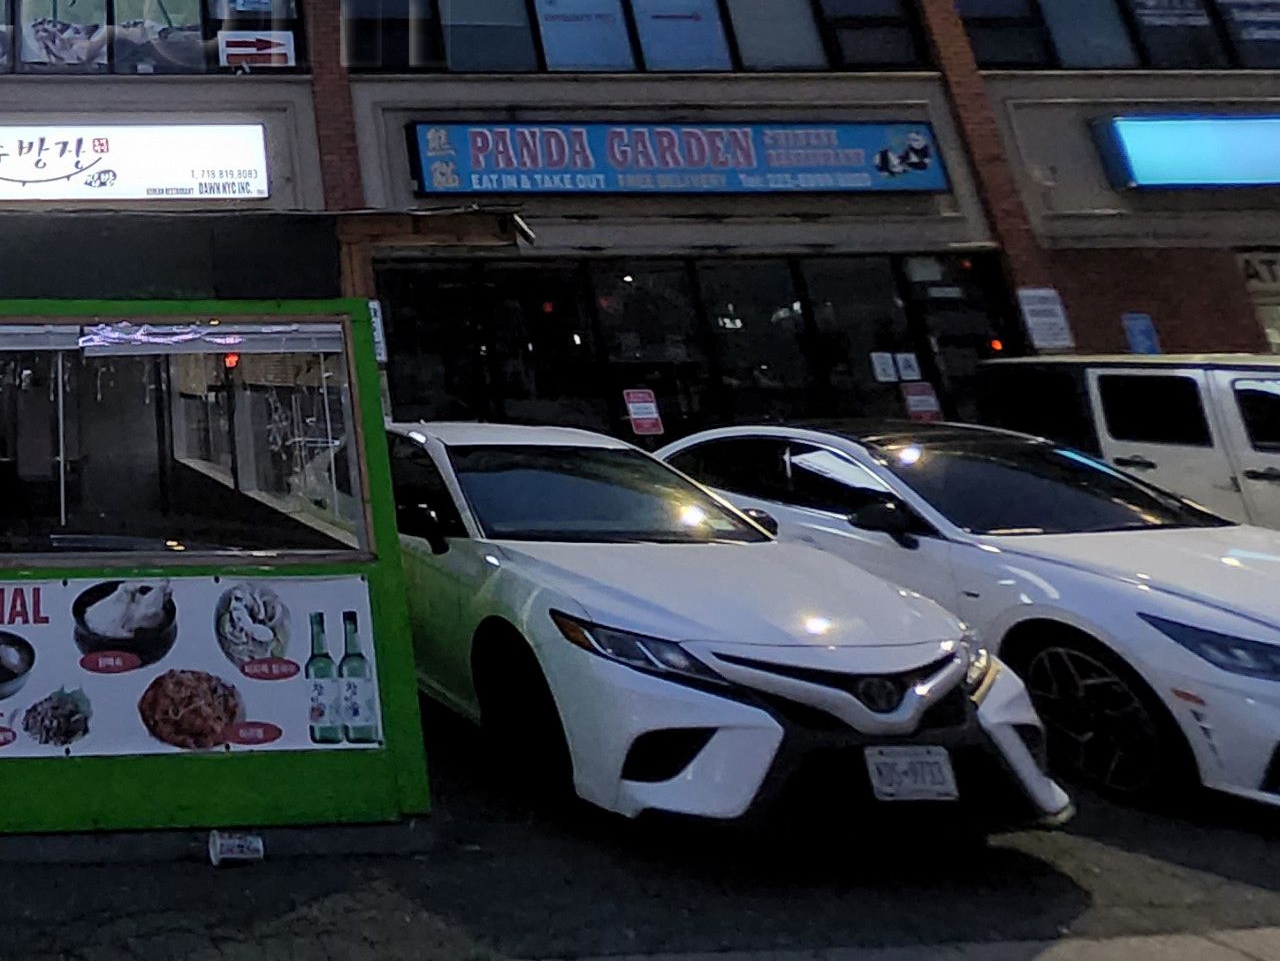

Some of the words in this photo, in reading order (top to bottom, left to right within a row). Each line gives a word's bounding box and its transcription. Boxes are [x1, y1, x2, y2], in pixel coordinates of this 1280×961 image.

[469, 127, 595, 170] PANDA
[608, 127, 758, 170] GARDEN
[471, 173, 499, 189] EAT
[502, 173, 518, 189] IN
[534, 173, 571, 189] TAKE
[575, 173, 606, 189] OUT
